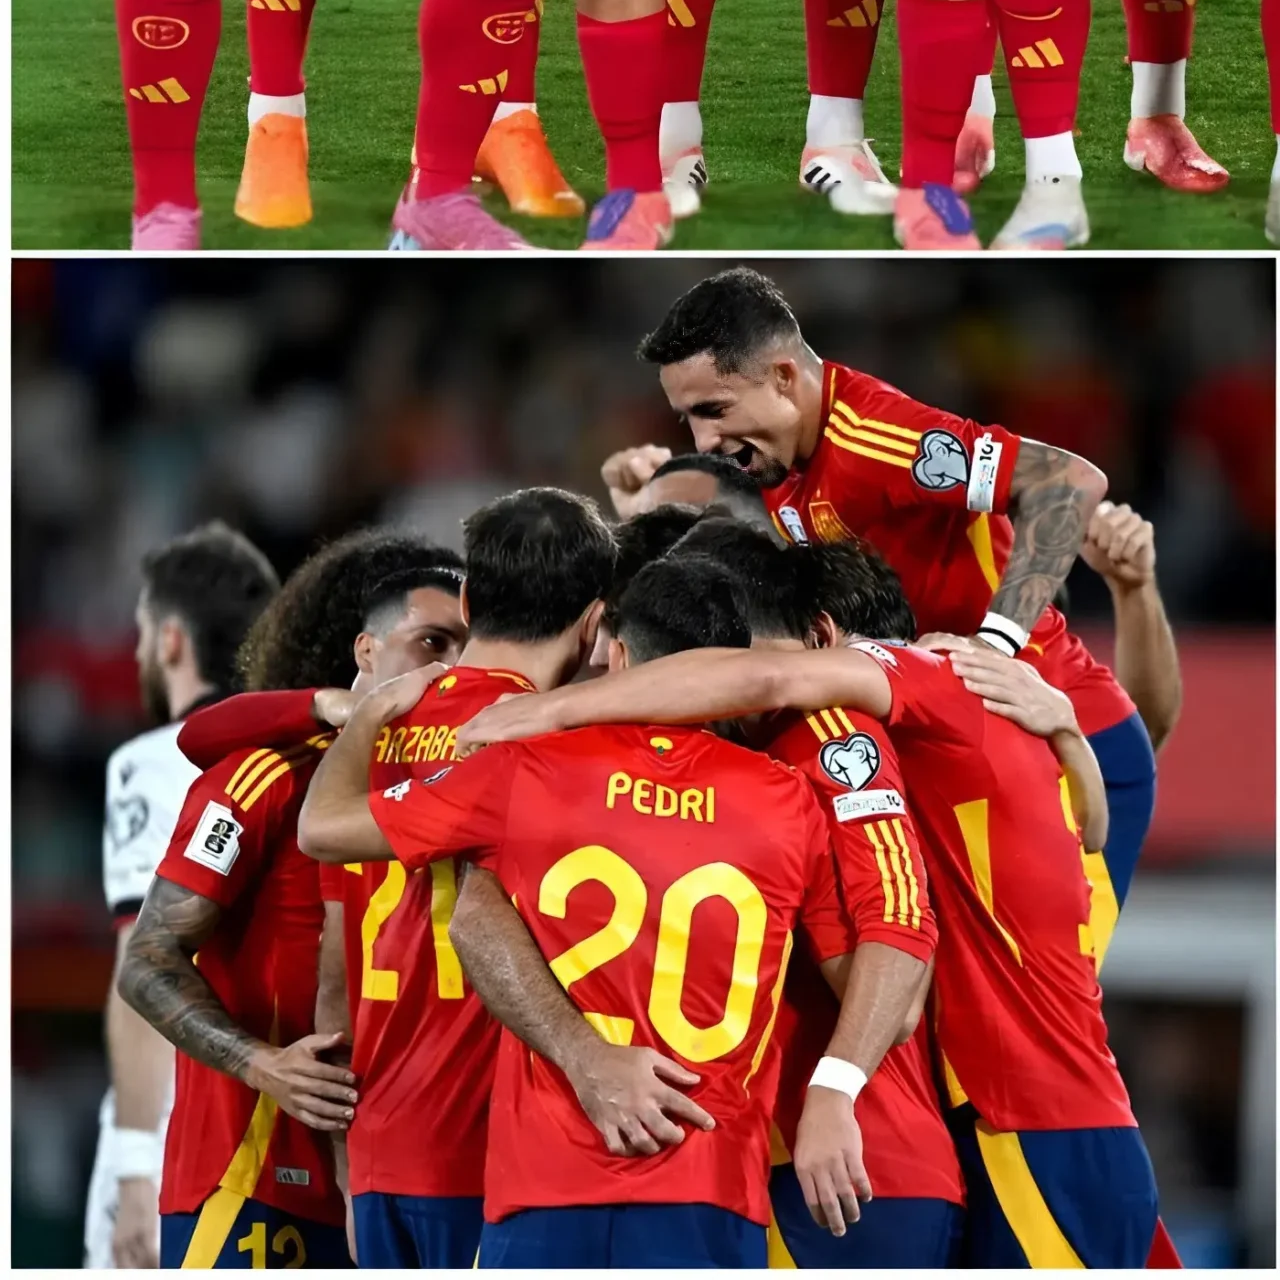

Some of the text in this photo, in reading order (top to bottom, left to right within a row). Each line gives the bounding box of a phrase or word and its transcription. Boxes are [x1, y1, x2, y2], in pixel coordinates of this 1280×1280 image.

[375, 725, 464, 763] ARZABA
[606, 771, 716, 823] PEDRI
[538, 845, 768, 1063] 20
[237, 1222, 307, 1270] 12
